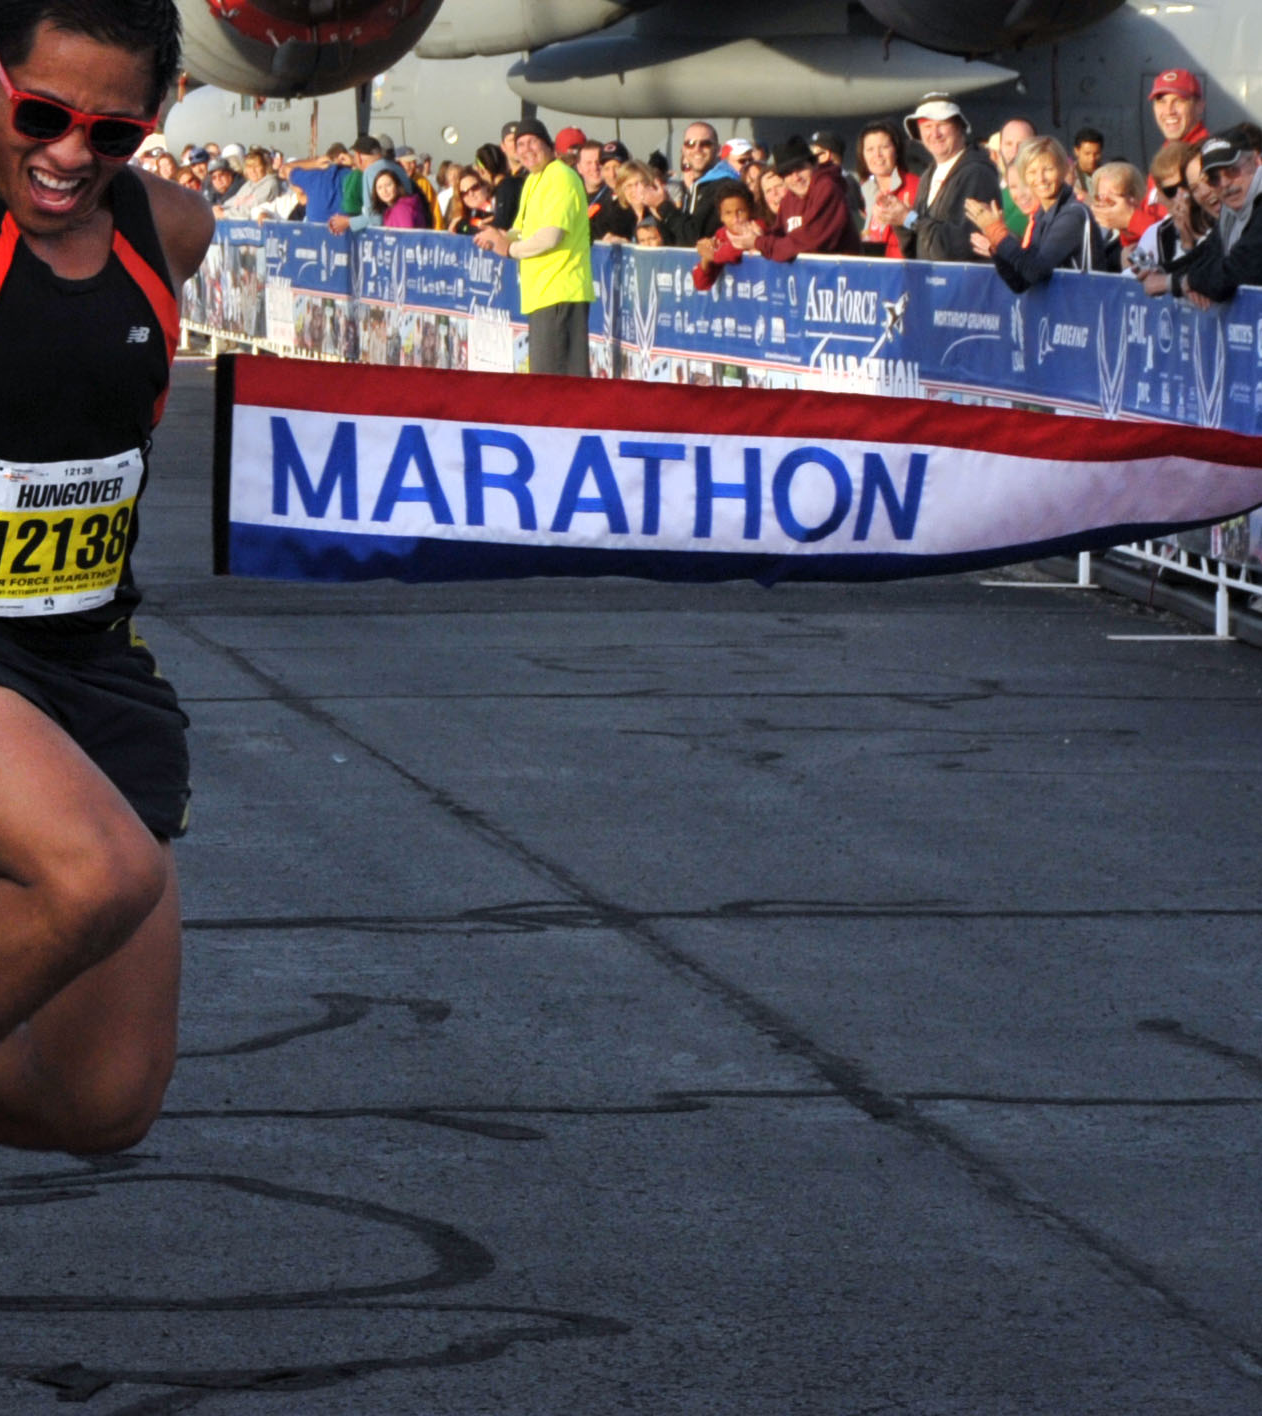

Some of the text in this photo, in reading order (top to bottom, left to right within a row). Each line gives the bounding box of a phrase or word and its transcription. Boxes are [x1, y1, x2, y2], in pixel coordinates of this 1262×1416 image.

[804, 276, 879, 326] AIR FORCE
[1052, 323, 1089, 349] BOEING
[64, 466, 94, 477] 12138
[269, 415, 929, 543] MARATHON
[16, 476, 124, 509] HUNGOVER
[9, 575, 50, 586] FORCE
[53, 568, 118, 584] MARATHON
